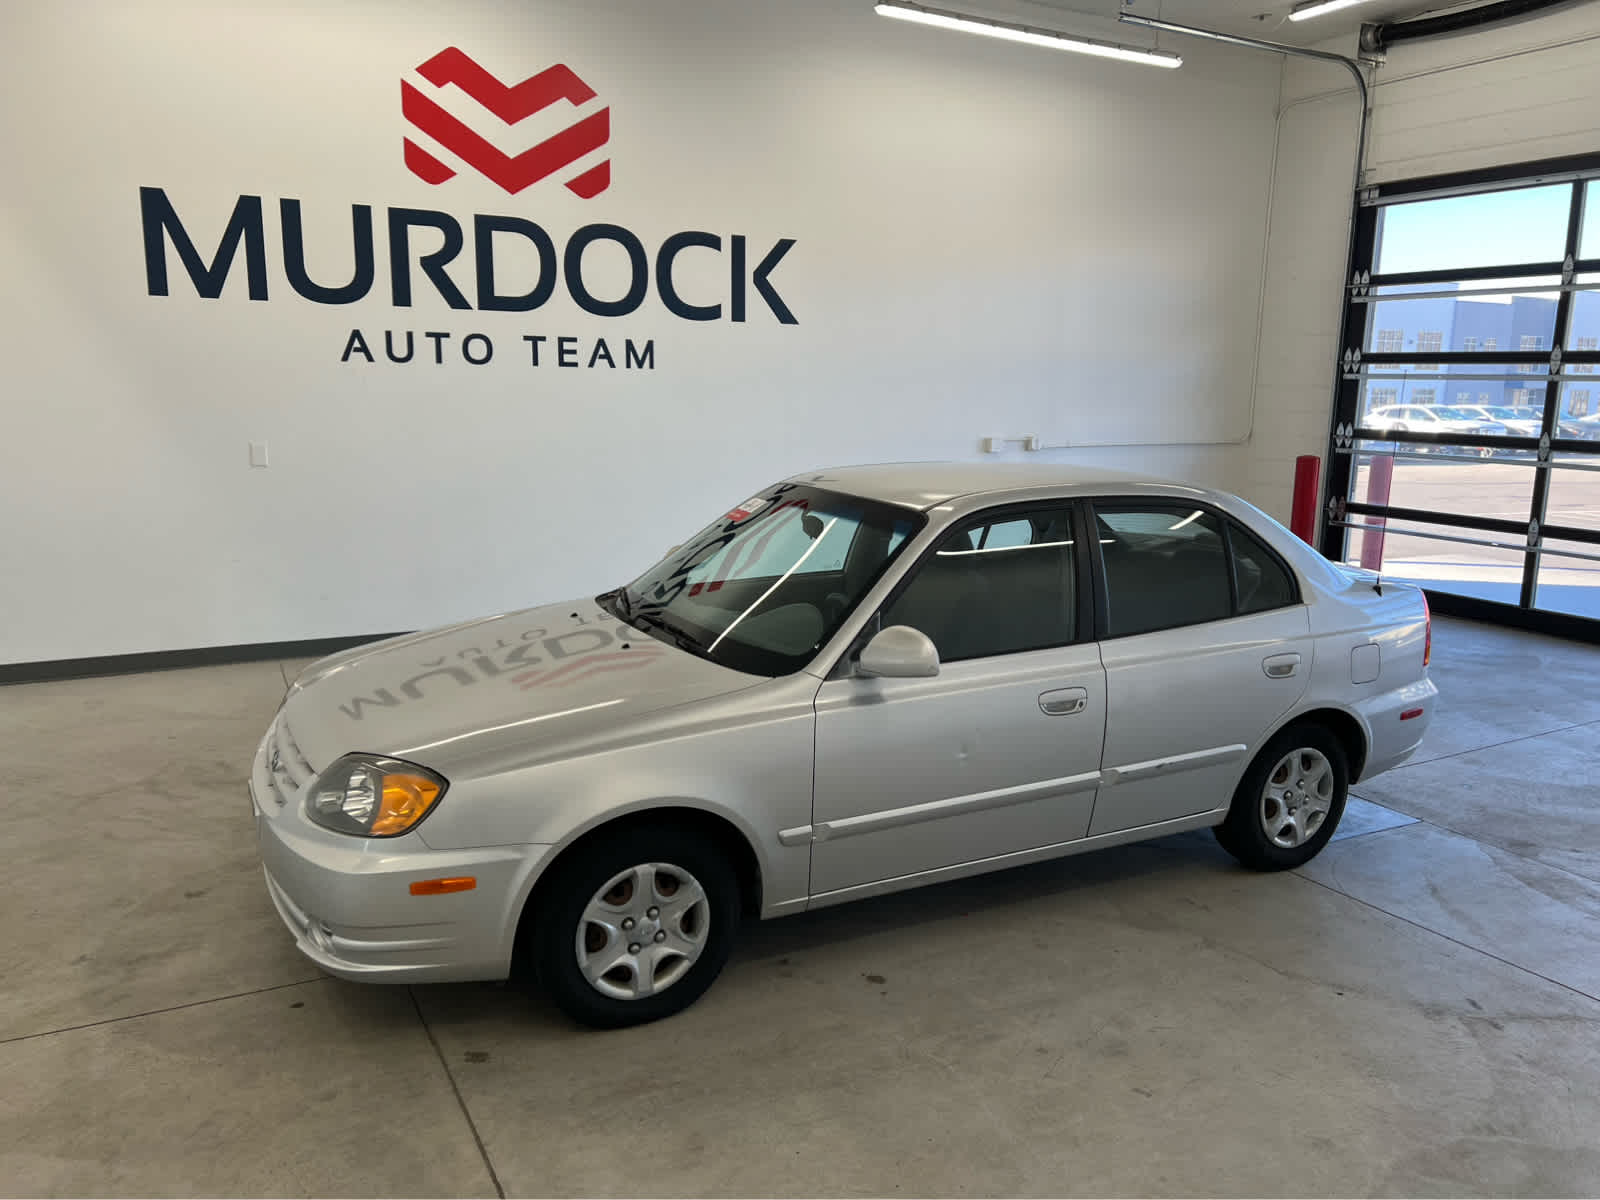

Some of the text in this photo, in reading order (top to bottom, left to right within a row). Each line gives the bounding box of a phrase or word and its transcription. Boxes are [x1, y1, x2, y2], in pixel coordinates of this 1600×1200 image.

[140, 187, 798, 325] MURDOCK
[341, 329, 655, 369] AUTO TEAM
